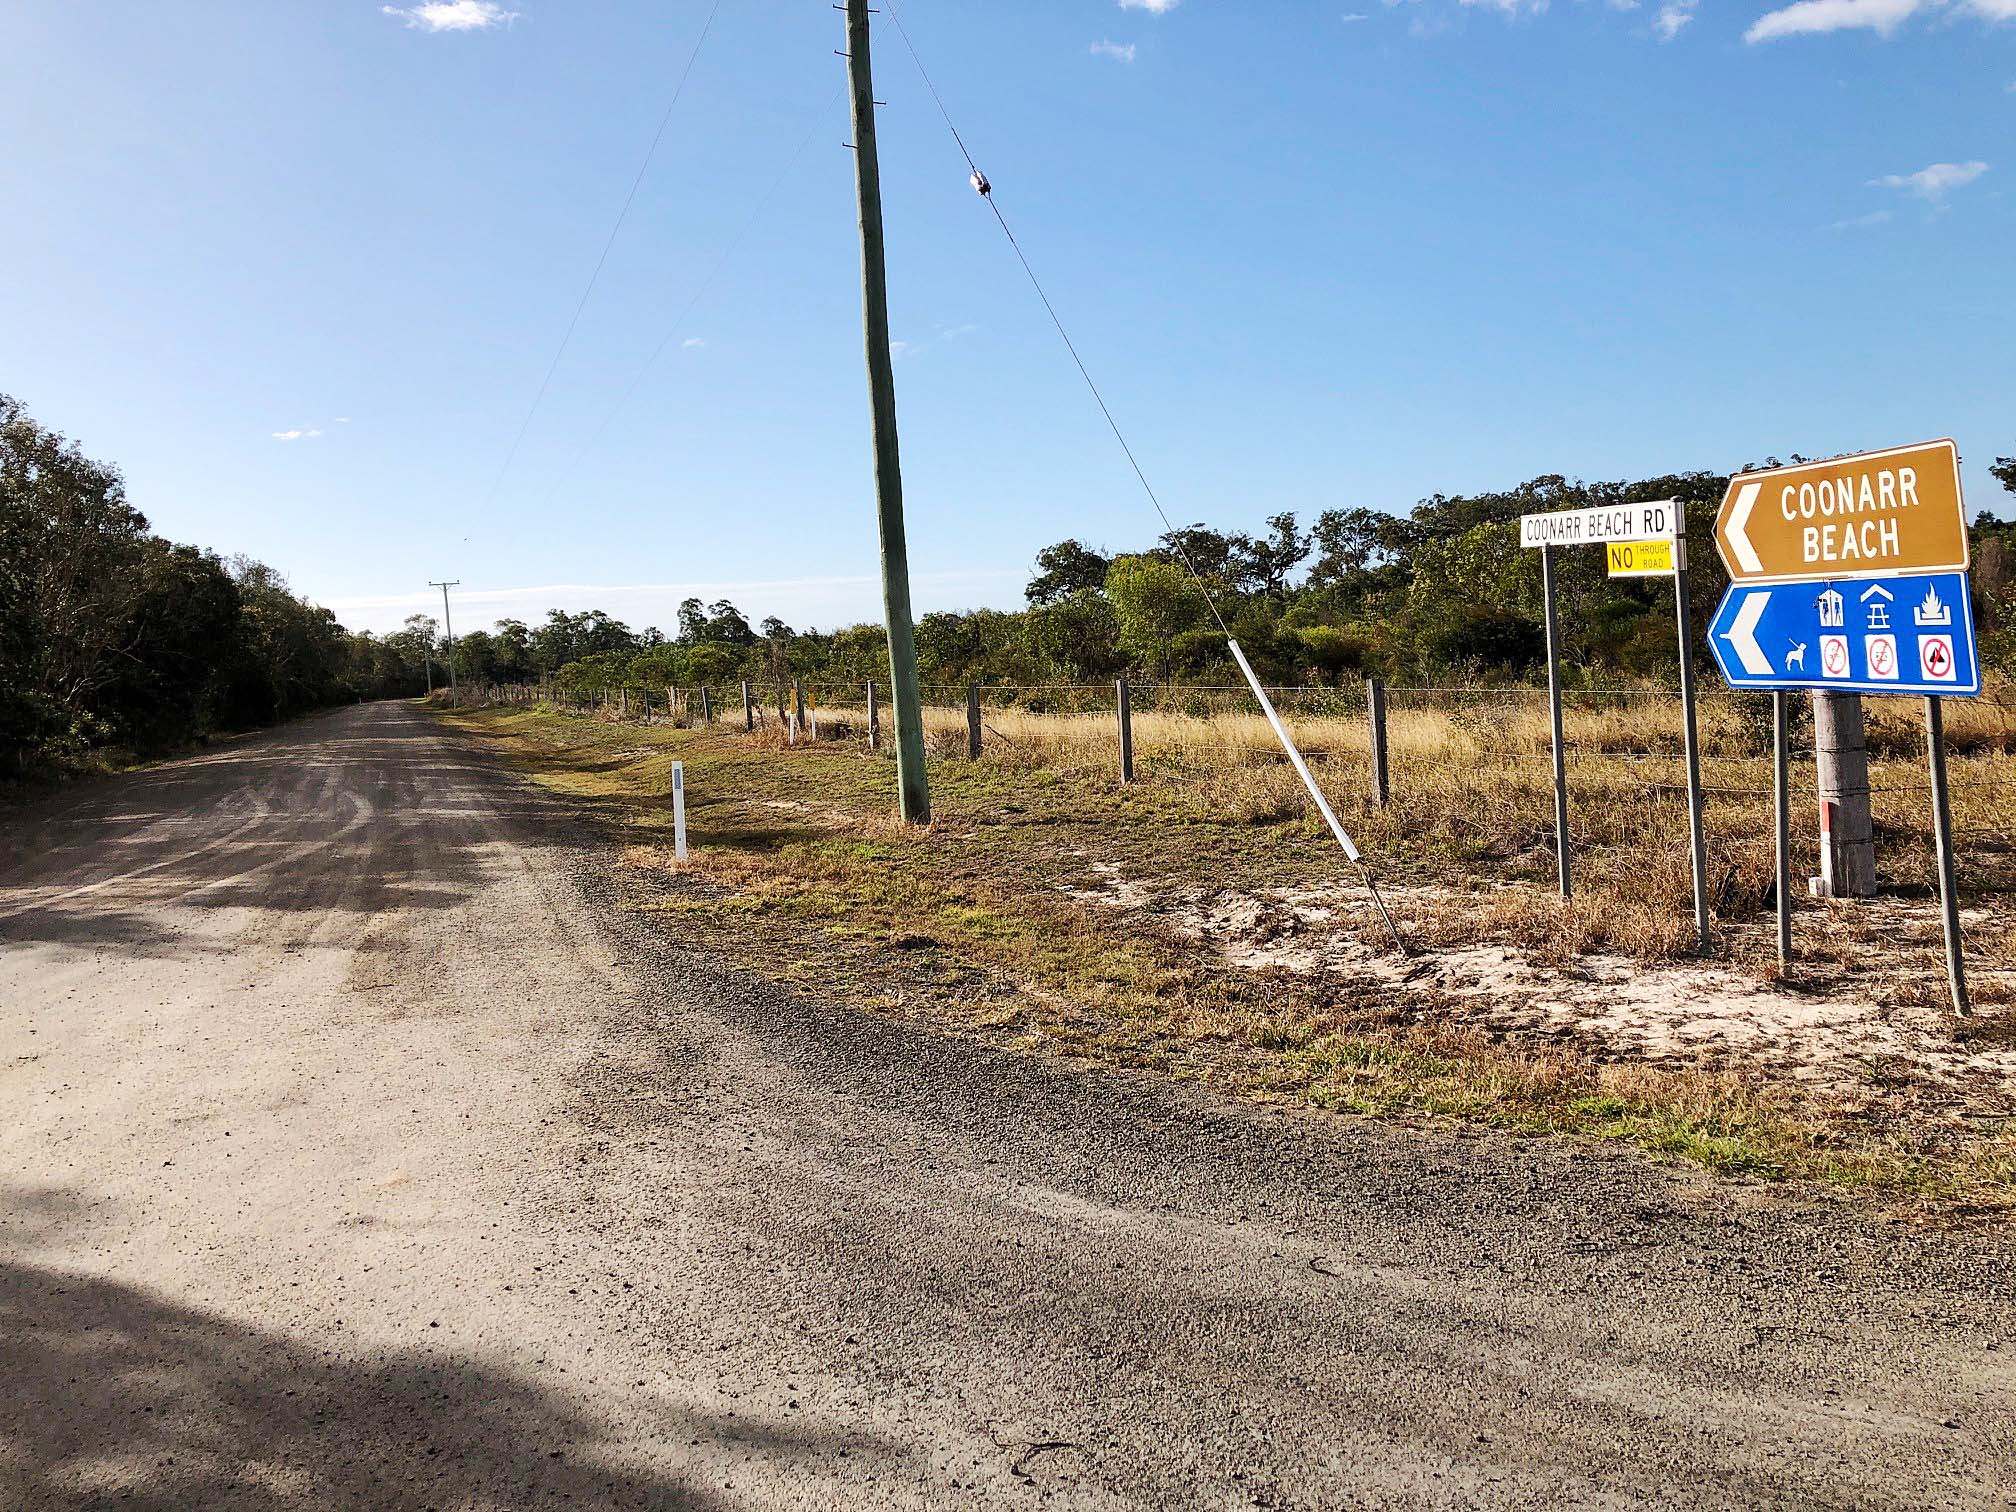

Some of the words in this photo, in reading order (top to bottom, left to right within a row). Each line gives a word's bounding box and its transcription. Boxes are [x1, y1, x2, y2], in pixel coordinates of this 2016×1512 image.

[1781, 467, 1920, 521] COONARR
[1526, 516, 1581, 541] COONARR
[1588, 511, 1632, 537] BEACH
[1644, 508, 1665, 533] RD
[1803, 518, 1900, 563] BEACH
[1611, 547, 1633, 569] NO
[1635, 545, 1670, 555] THROUGH
[1643, 558, 1664, 569] ROAD
